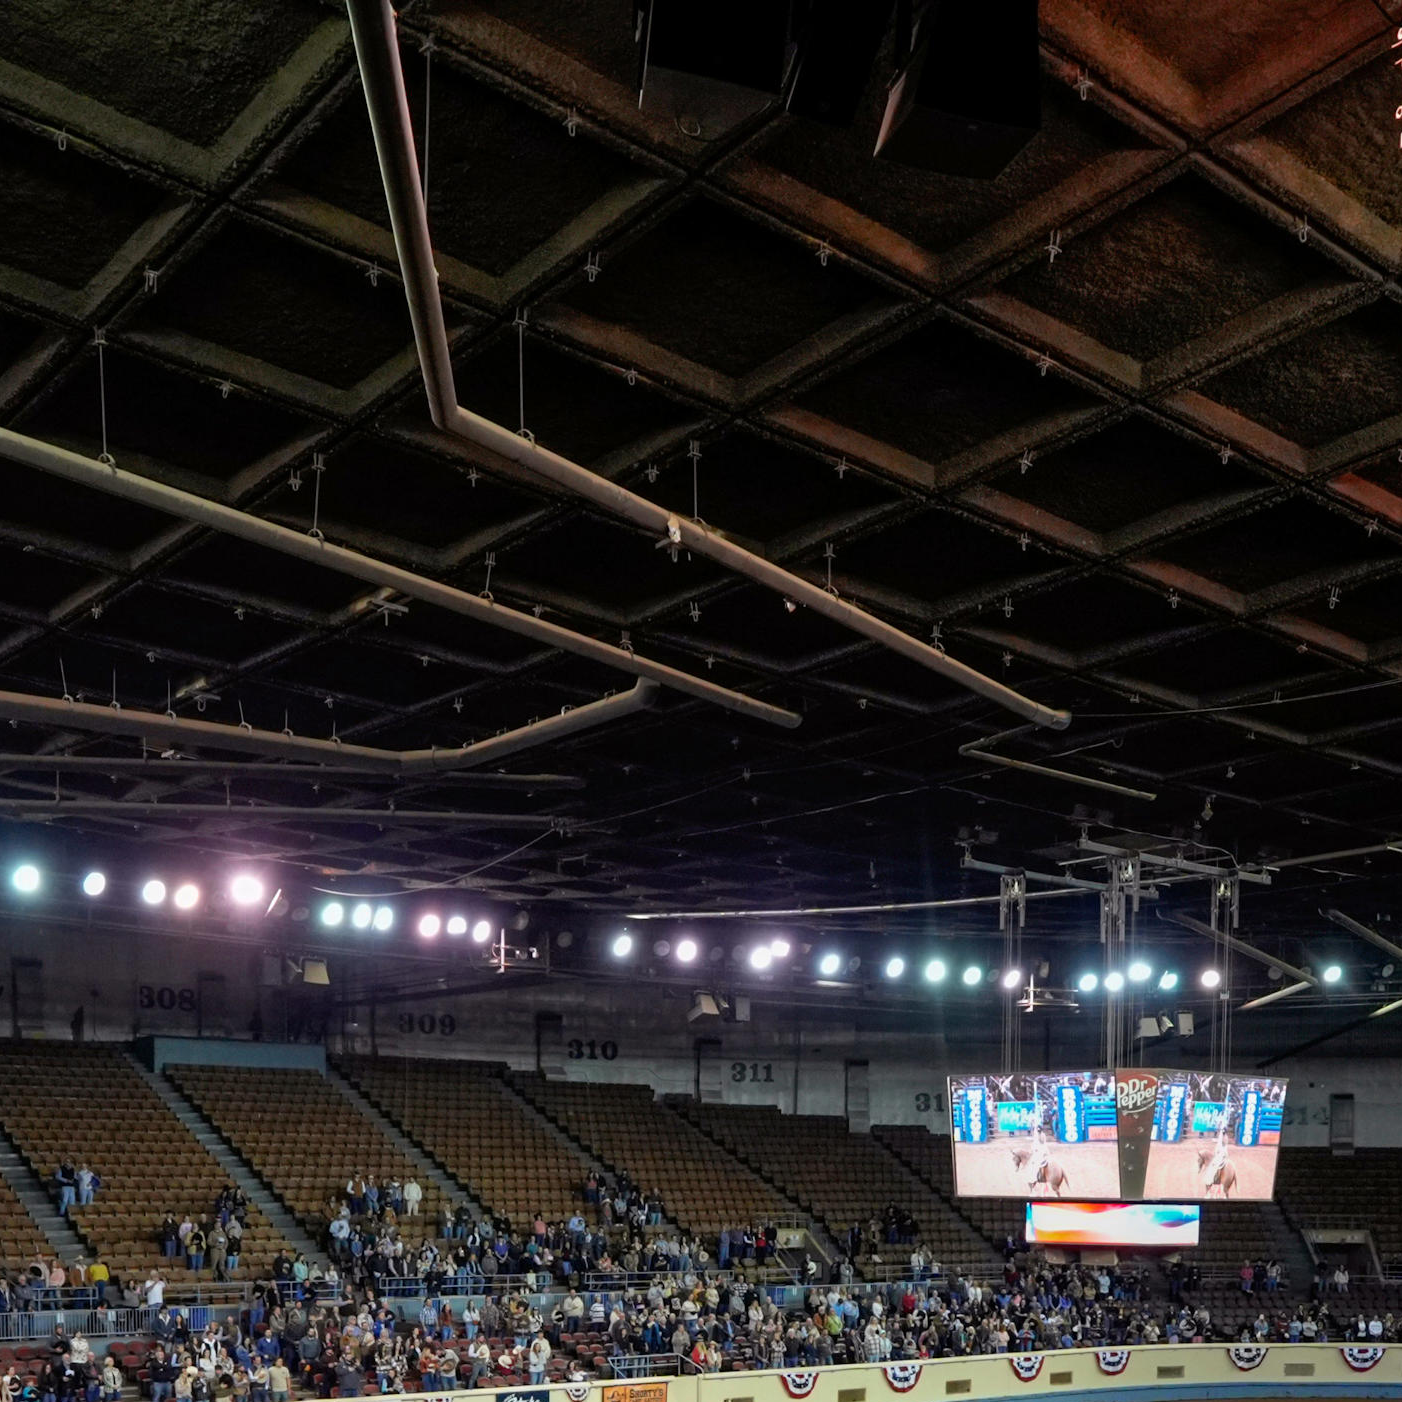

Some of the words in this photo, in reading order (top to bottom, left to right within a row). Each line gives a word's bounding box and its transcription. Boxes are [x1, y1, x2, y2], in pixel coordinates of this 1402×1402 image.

[139, 985, 196, 1012] 308
[568, 1038, 618, 1060] 310
[731, 1062, 775, 1083] 311
[1116, 1082, 1157, 1109] Pepper
[1128, 1079, 1147, 1093] Dr
[915, 1092, 945, 1112] 31
